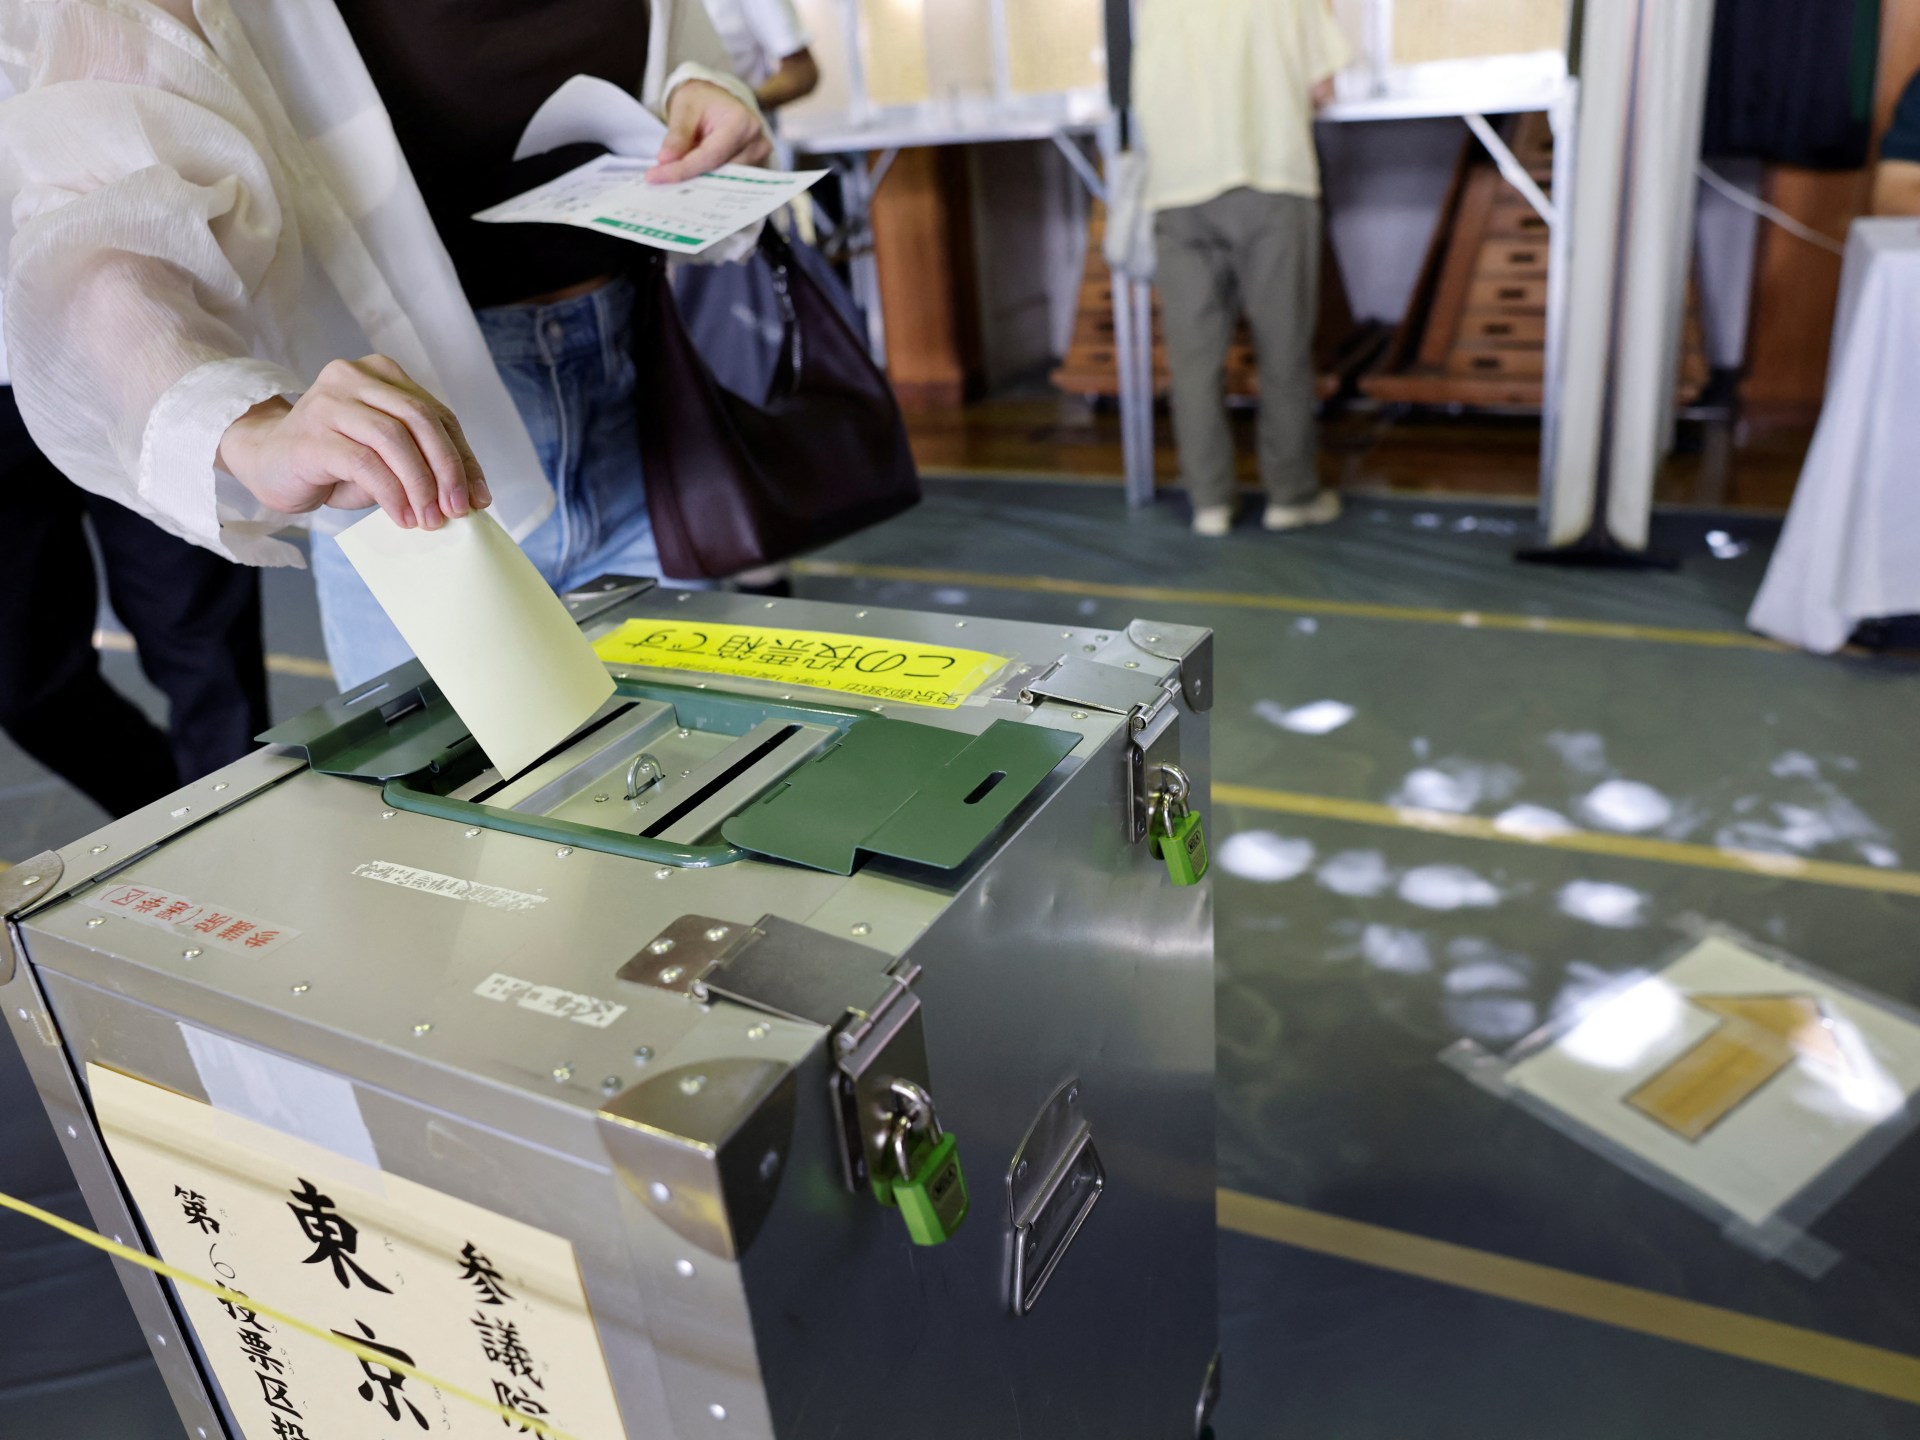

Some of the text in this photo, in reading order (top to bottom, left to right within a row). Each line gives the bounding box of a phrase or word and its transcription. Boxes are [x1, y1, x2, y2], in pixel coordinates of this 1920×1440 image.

[625, 629, 957, 679] この投票箱です
